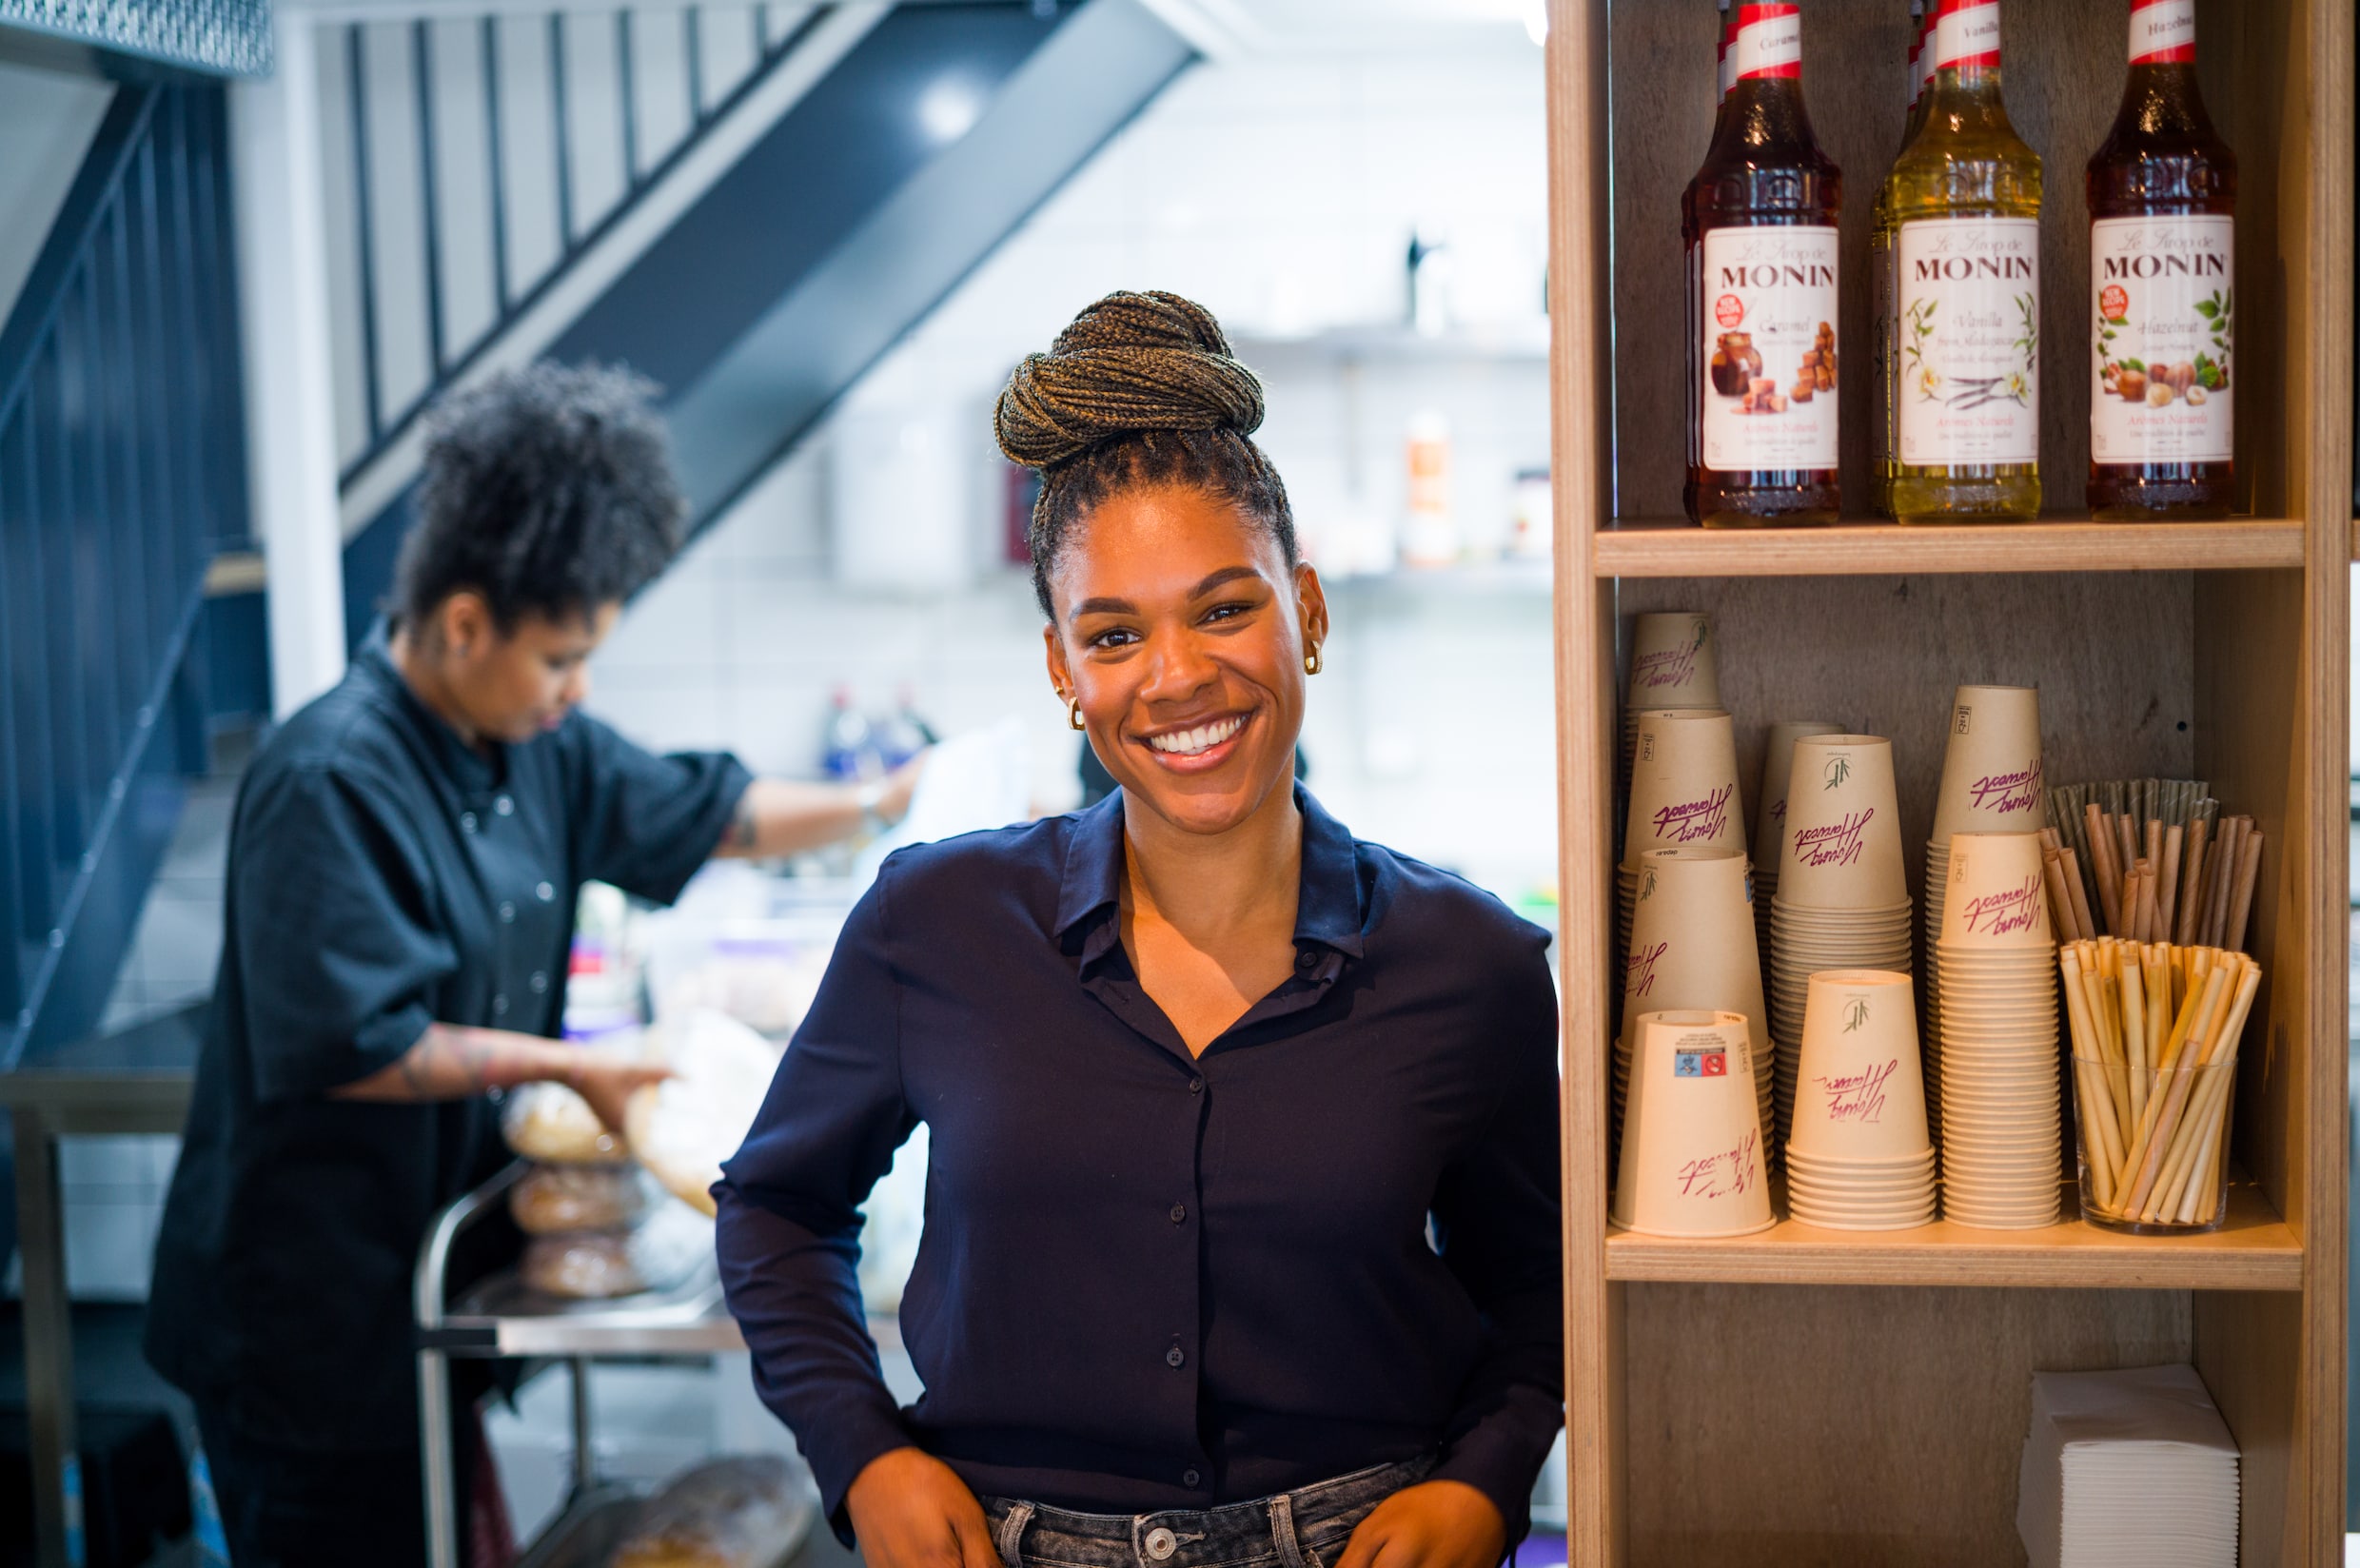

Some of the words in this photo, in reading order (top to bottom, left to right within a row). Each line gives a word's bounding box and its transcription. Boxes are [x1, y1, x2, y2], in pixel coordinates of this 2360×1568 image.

[1812, 247, 1827, 260] de
[1928, 231, 1956, 253] Le
[1958, 230, 2004, 256] Sirop
[2006, 238, 2023, 252] de
[2116, 228, 2143, 251] Le
[2147, 227, 2195, 253] Sirop
[2197, 235, 2213, 248] de
[1721, 265, 1834, 288] MONIN
[1915, 256, 2032, 283] MONIN
[2103, 253, 2224, 281] MONIN
[1953, 310, 2003, 328] Vanilla
[2137, 315, 2199, 334] Hazelnut
[1970, 755, 2043, 808] Harvest
[1653, 783, 1733, 838] Harvest
[1985, 788, 2041, 813] Young
[1667, 815, 1727, 843] Young
[1794, 808, 1874, 856] Harvest
[1800, 841, 1863, 867] Young
[1963, 869, 2042, 932] Harvest
[1979, 905, 2041, 936] Young
[1827, 1094, 1886, 1123] Young
